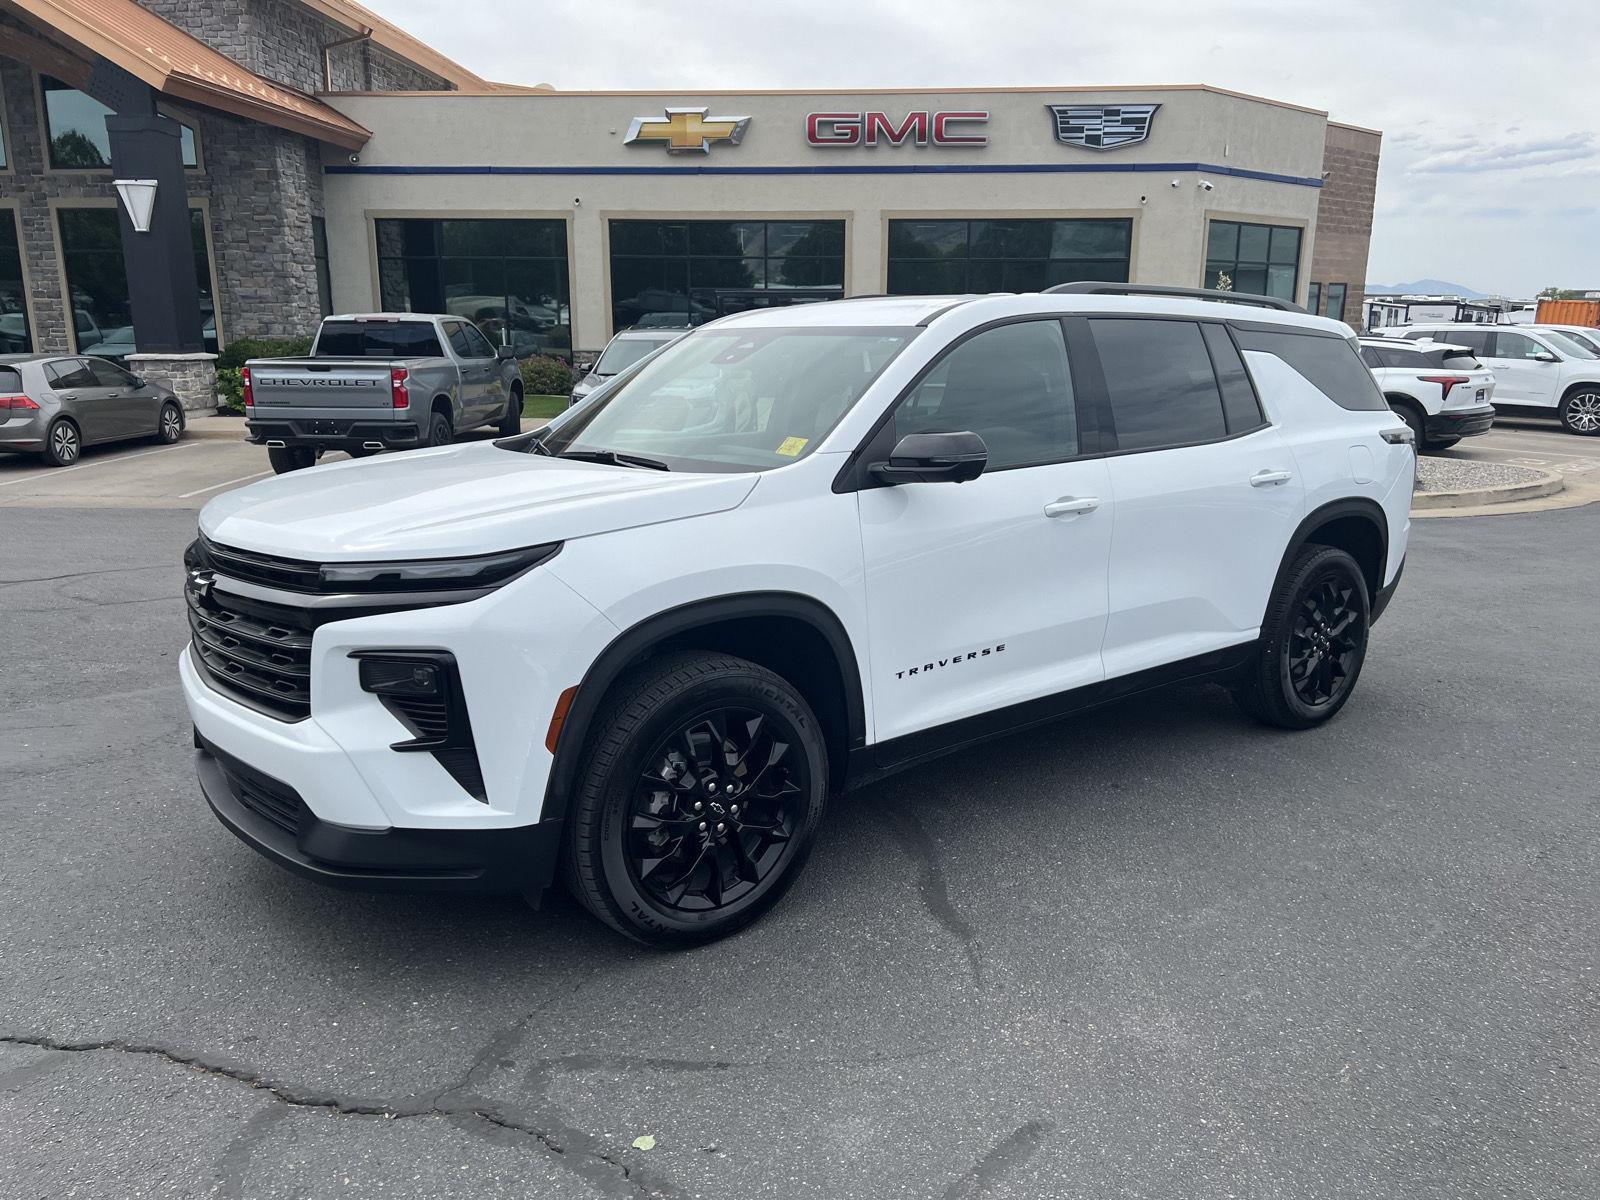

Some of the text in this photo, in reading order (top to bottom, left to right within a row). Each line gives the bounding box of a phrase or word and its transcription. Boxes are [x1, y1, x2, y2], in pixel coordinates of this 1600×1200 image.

[806, 110, 990, 148] GMC
[259, 378, 381, 387] CHEVROLET
[895, 643, 1006, 680] TRAVERSE
